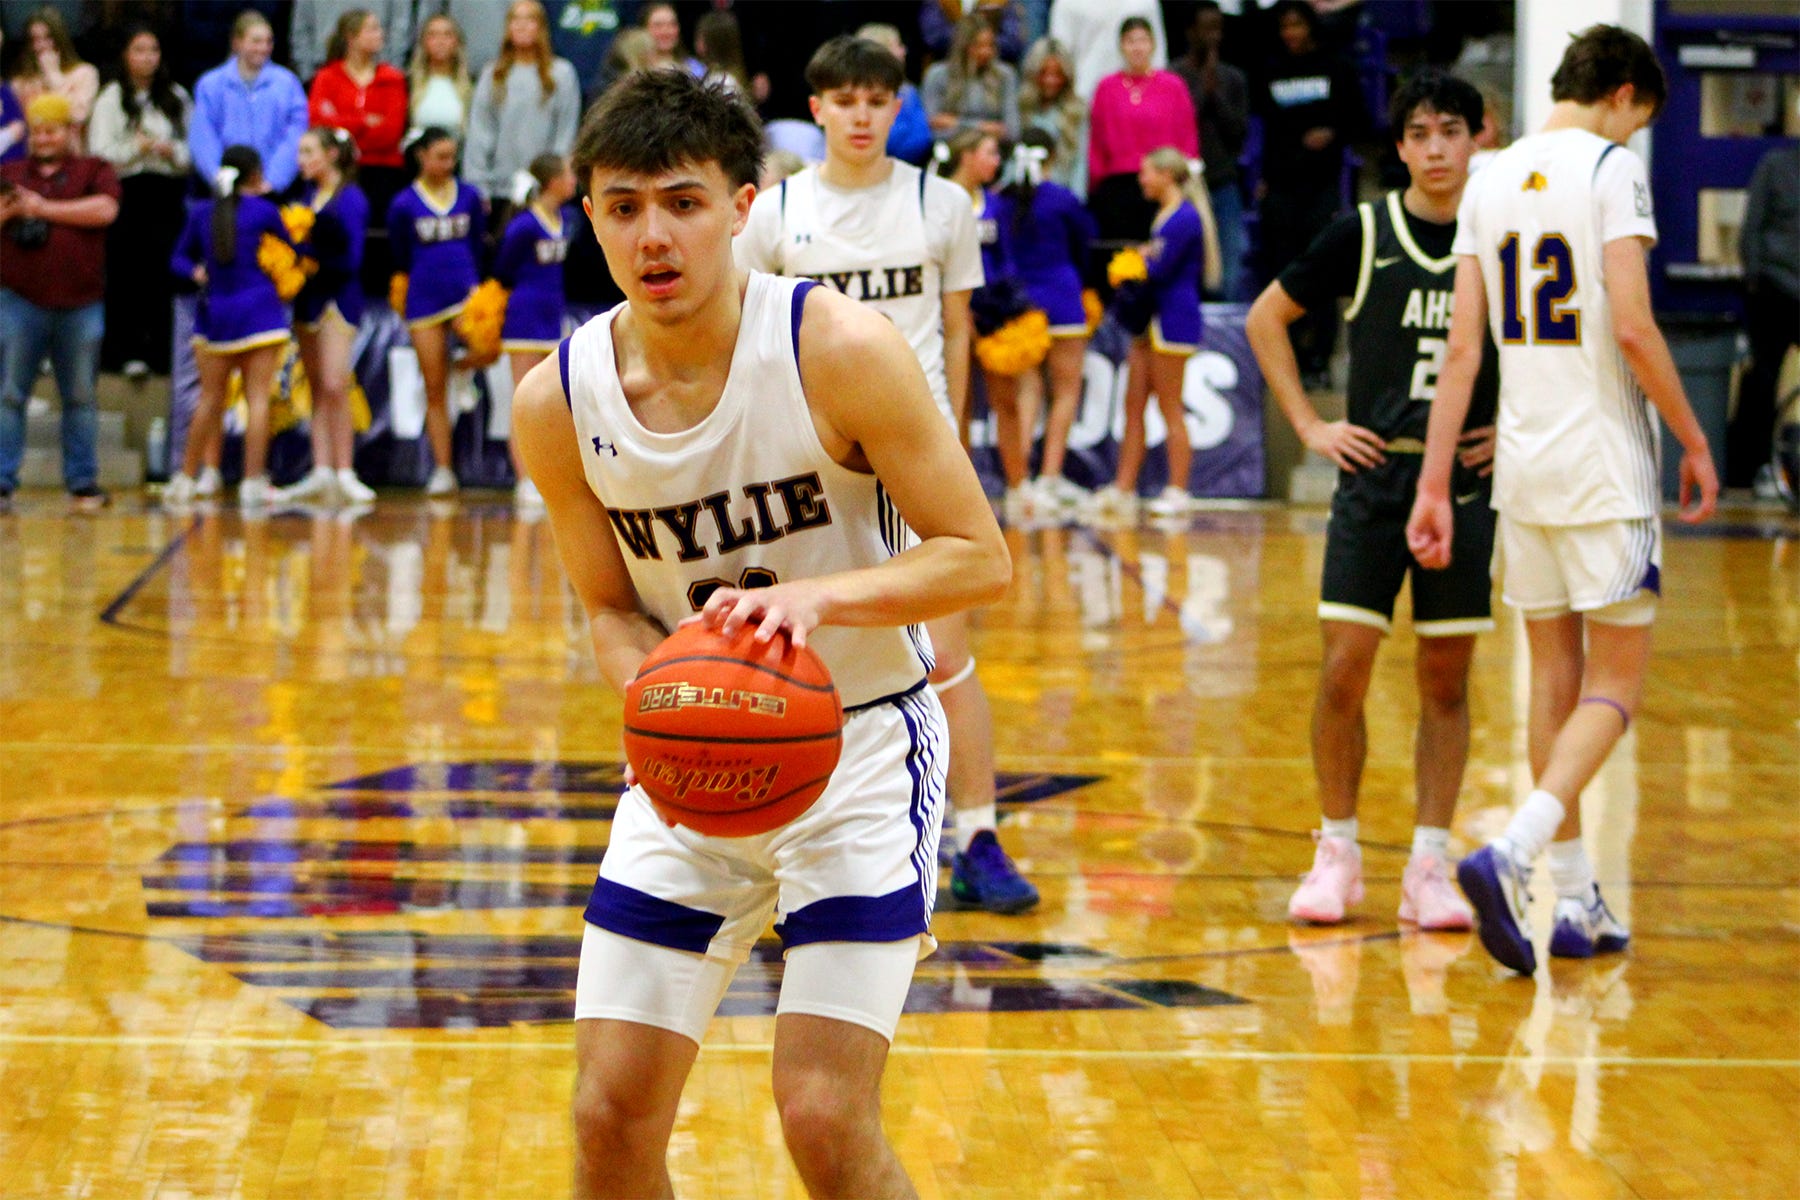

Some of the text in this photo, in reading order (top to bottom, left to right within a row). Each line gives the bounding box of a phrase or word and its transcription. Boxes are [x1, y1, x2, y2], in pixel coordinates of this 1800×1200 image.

[795, 265, 923, 302] YLIE
[1498, 232, 1582, 345] 12
[606, 471, 832, 563] WYLIE
[638, 681, 787, 719] ELITE PRO
[642, 756, 782, 803] Baden
